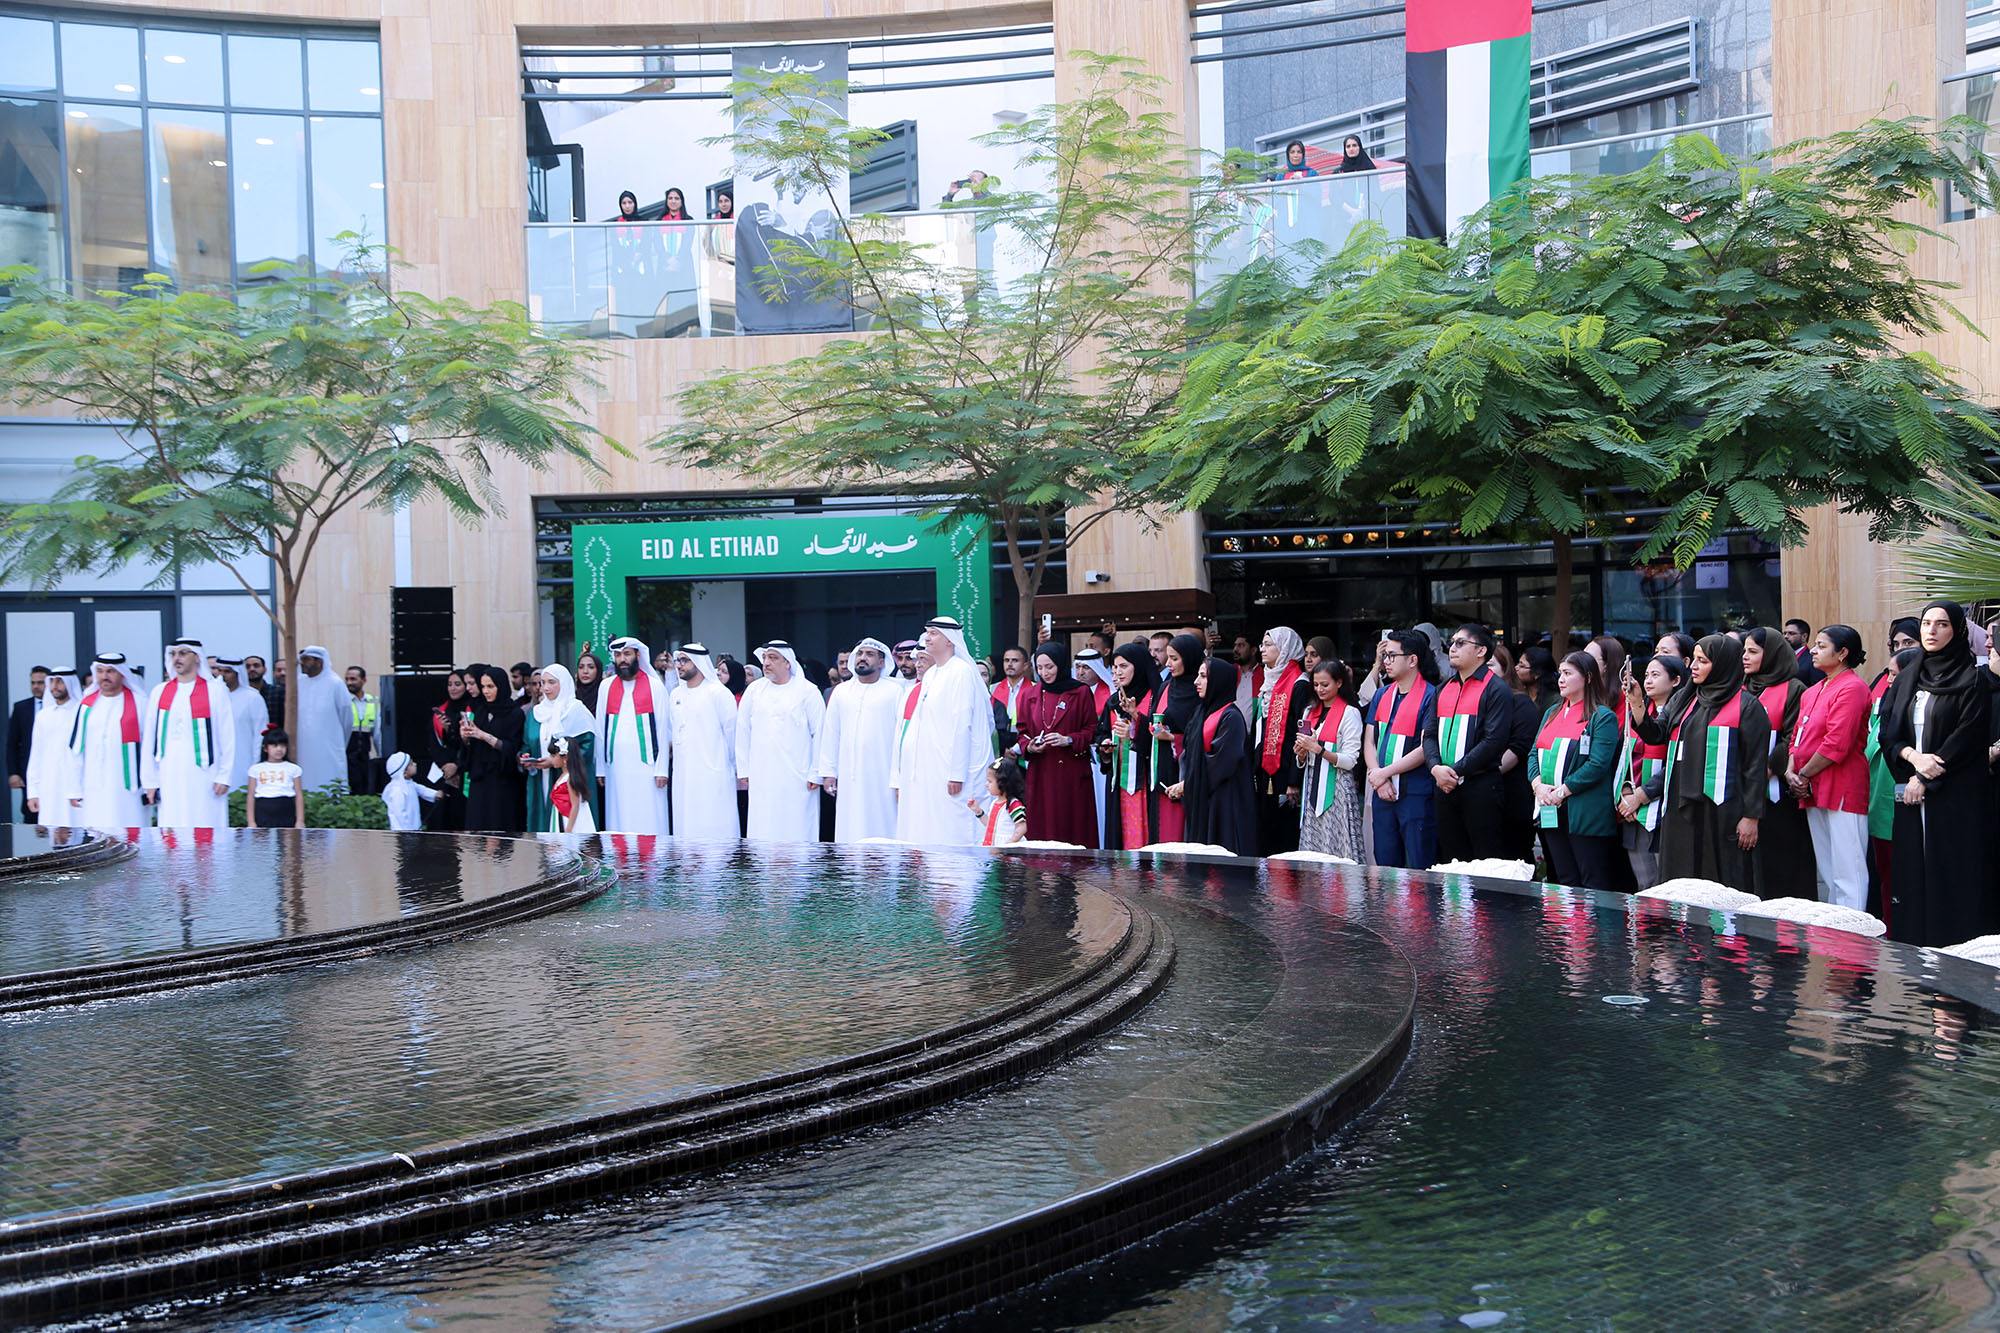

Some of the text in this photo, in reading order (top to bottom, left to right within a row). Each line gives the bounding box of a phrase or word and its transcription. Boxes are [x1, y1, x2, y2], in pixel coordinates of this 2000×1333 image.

[793, 59, 826, 74] عيد
[641, 535, 779, 560] EID AL ETIHAD
[803, 527, 918, 558] عيد الاتحاد
